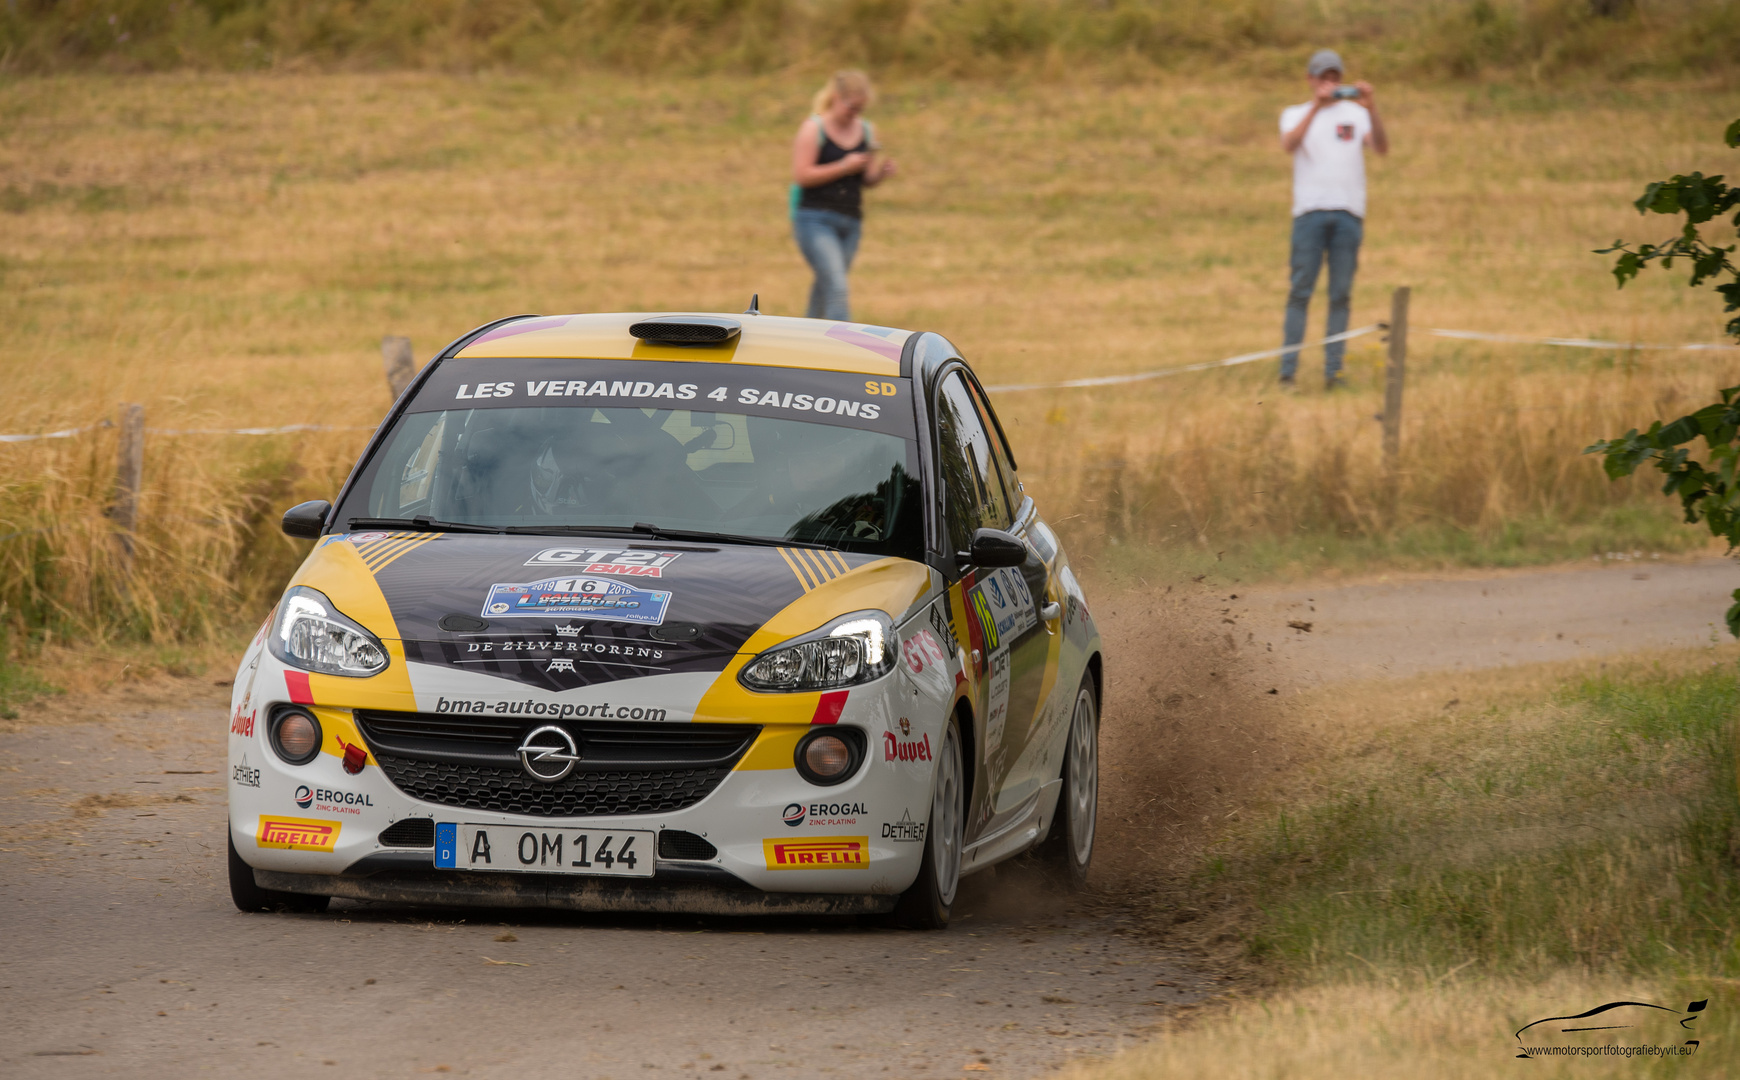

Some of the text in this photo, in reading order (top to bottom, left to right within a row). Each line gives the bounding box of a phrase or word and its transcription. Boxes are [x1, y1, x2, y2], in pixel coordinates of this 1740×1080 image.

[865, 381, 897, 396] SD
[456, 380, 880, 420] LES VERANDAS 4 SAISONS
[584, 564, 661, 577] BMA
[532, 582, 554, 592] 2019
[566, 580, 597, 593] 16
[608, 584, 632, 595] 2019
[973, 590, 997, 649] 16
[468, 641, 663, 659] DE ZILVERTORENS
[903, 629, 944, 674] GTS
[436, 697, 667, 721] bma-autosport.com
[882, 730, 932, 763] Duvel
[316, 789, 373, 807] EROGAL
[316, 804, 360, 815] ZINC PLATING
[809, 803, 868, 816] EROGAL
[828, 818, 856, 826] PLATING
[881, 822, 925, 839] DETHIER
[262, 821, 333, 846] PIRELLI
[442, 849, 450, 860] D
[471, 830, 492, 864] A
[773, 842, 861, 864] PIRELLI
